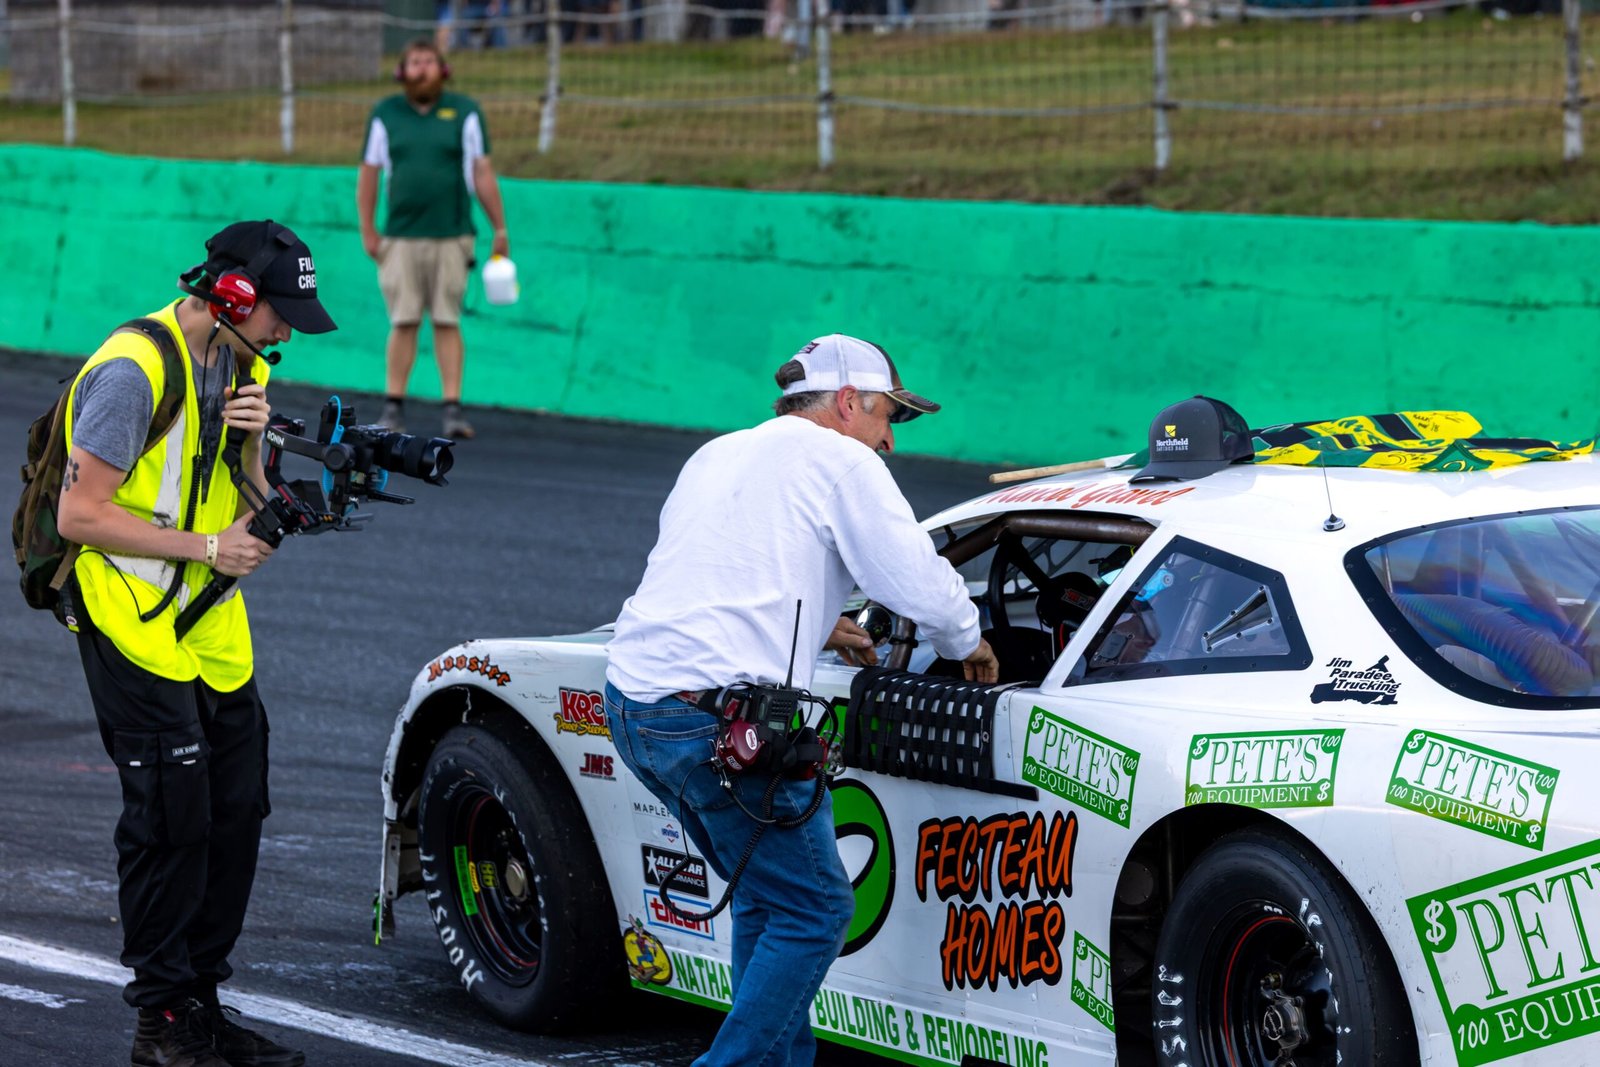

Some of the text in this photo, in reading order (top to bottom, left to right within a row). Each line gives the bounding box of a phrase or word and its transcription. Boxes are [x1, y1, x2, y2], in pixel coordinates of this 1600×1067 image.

[1156, 437, 1189, 447] Northfield
[1326, 657, 1352, 668] Jim
[1329, 668, 1392, 681] Paradee
[1337, 679, 1401, 694] Trucking
[559, 686, 606, 727] KRC
[580, 753, 614, 776] JMS
[1039, 721, 1123, 797] PETE'S
[1123, 756, 1137, 771] 100
[1206, 737, 1320, 785] PETE'S
[1322, 736, 1341, 748] 100
[1413, 740, 1535, 818] PETE'S
[1536, 773, 1556, 789] 100
[1024, 763, 1037, 777] 100
[1039, 768, 1115, 815] EQUIPMENT
[1187, 792, 1203, 804] 100
[1206, 786, 1312, 804] EQUIPMENT
[1389, 784, 1408, 799] 100
[1410, 789, 1522, 838] EQUIPMENT
[915, 811, 1078, 903] FECTEAU
[940, 900, 1065, 993] HOMES
[1456, 862, 1600, 1001] PET
[671, 951, 732, 1001] NATHA
[1072, 985, 1086, 1001] 100
[813, 989, 900, 1047] BUILDING
[905, 1009, 920, 1051] &
[1457, 1018, 1490, 1051] 100
